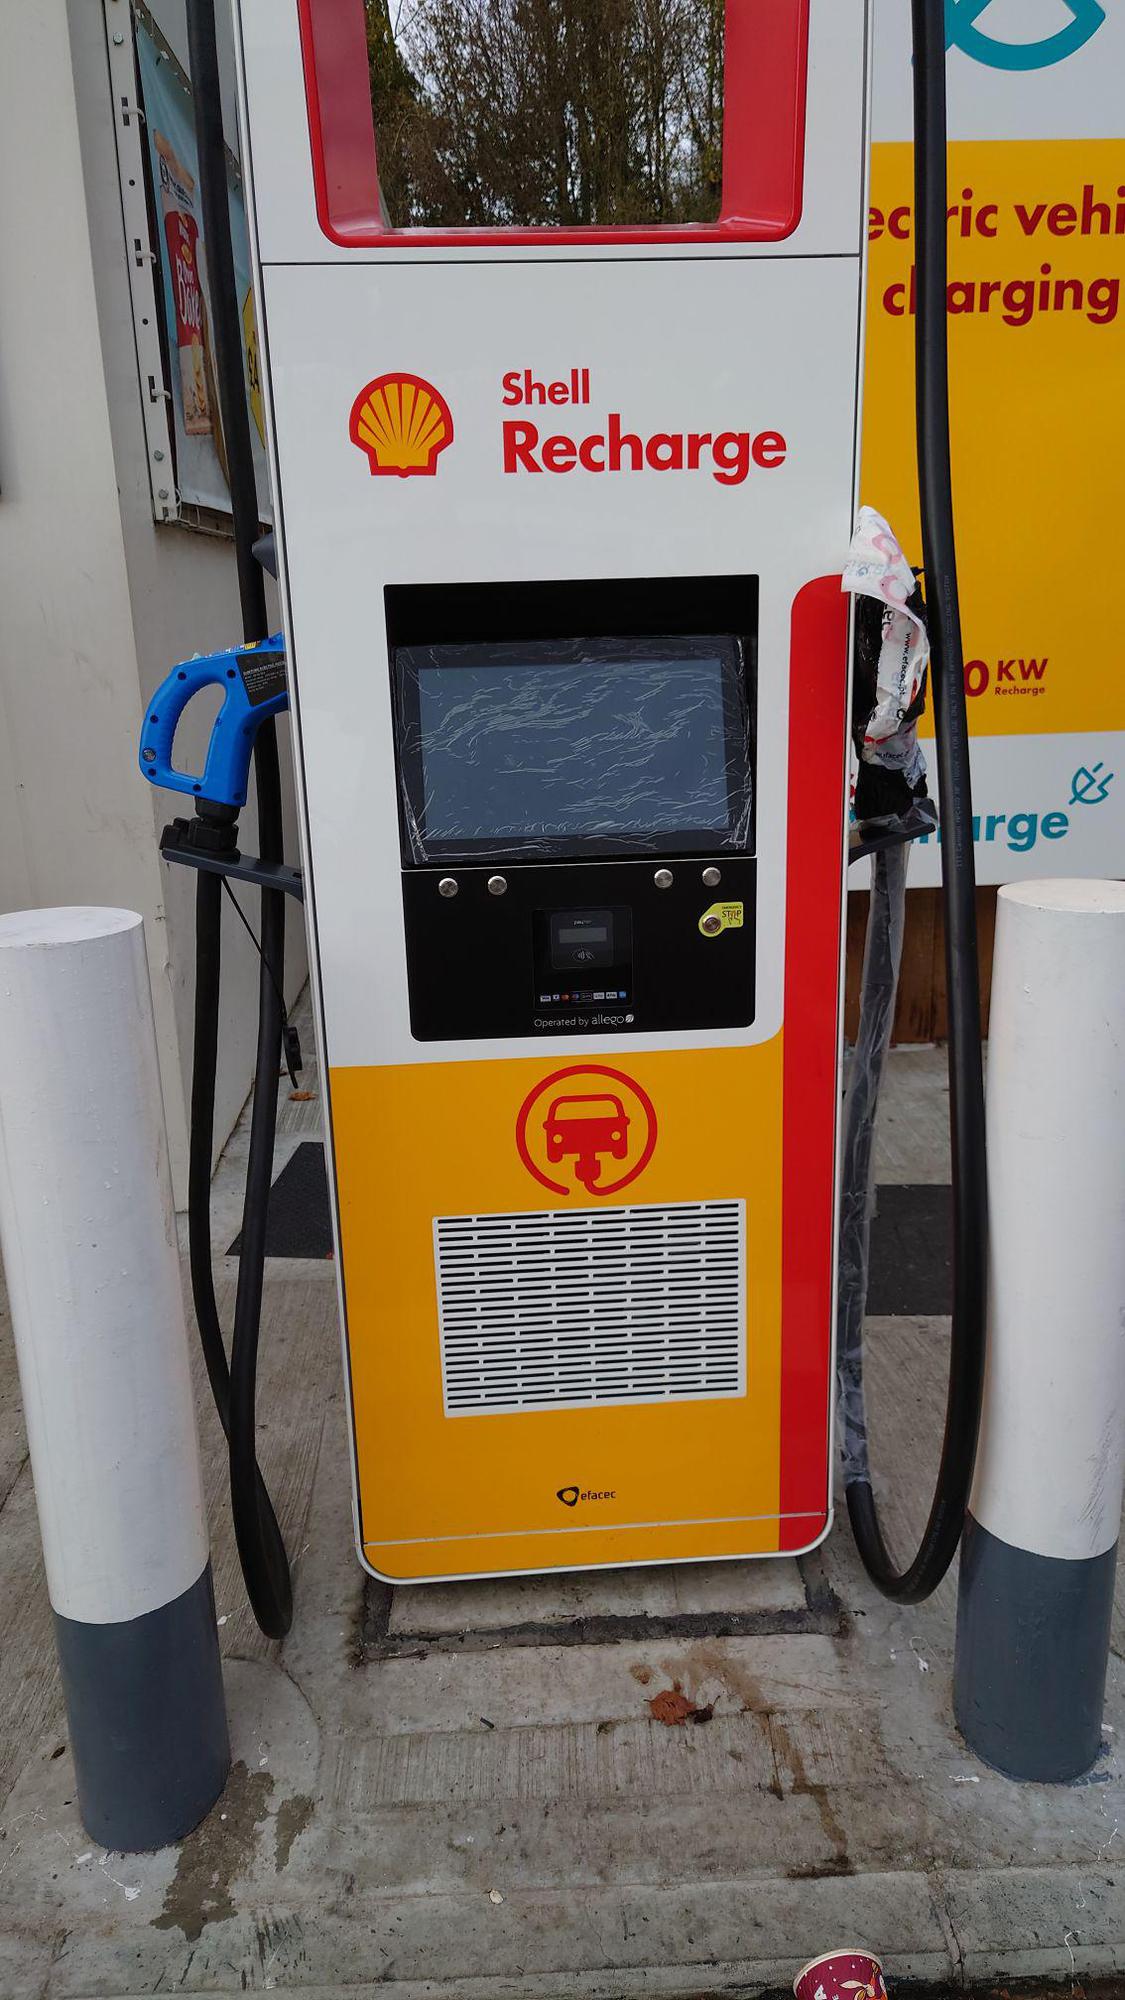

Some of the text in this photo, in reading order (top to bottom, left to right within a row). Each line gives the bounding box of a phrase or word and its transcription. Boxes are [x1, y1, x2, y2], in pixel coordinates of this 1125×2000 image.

[502, 368, 590, 406] Shell
[502, 413, 787, 486] Recharge
[996, 658, 1049, 681] KW
[994, 686, 1046, 697] Recharge
[533, 1013, 625, 1029] Operated by allego
[580, 1490, 616, 1500] efacec
